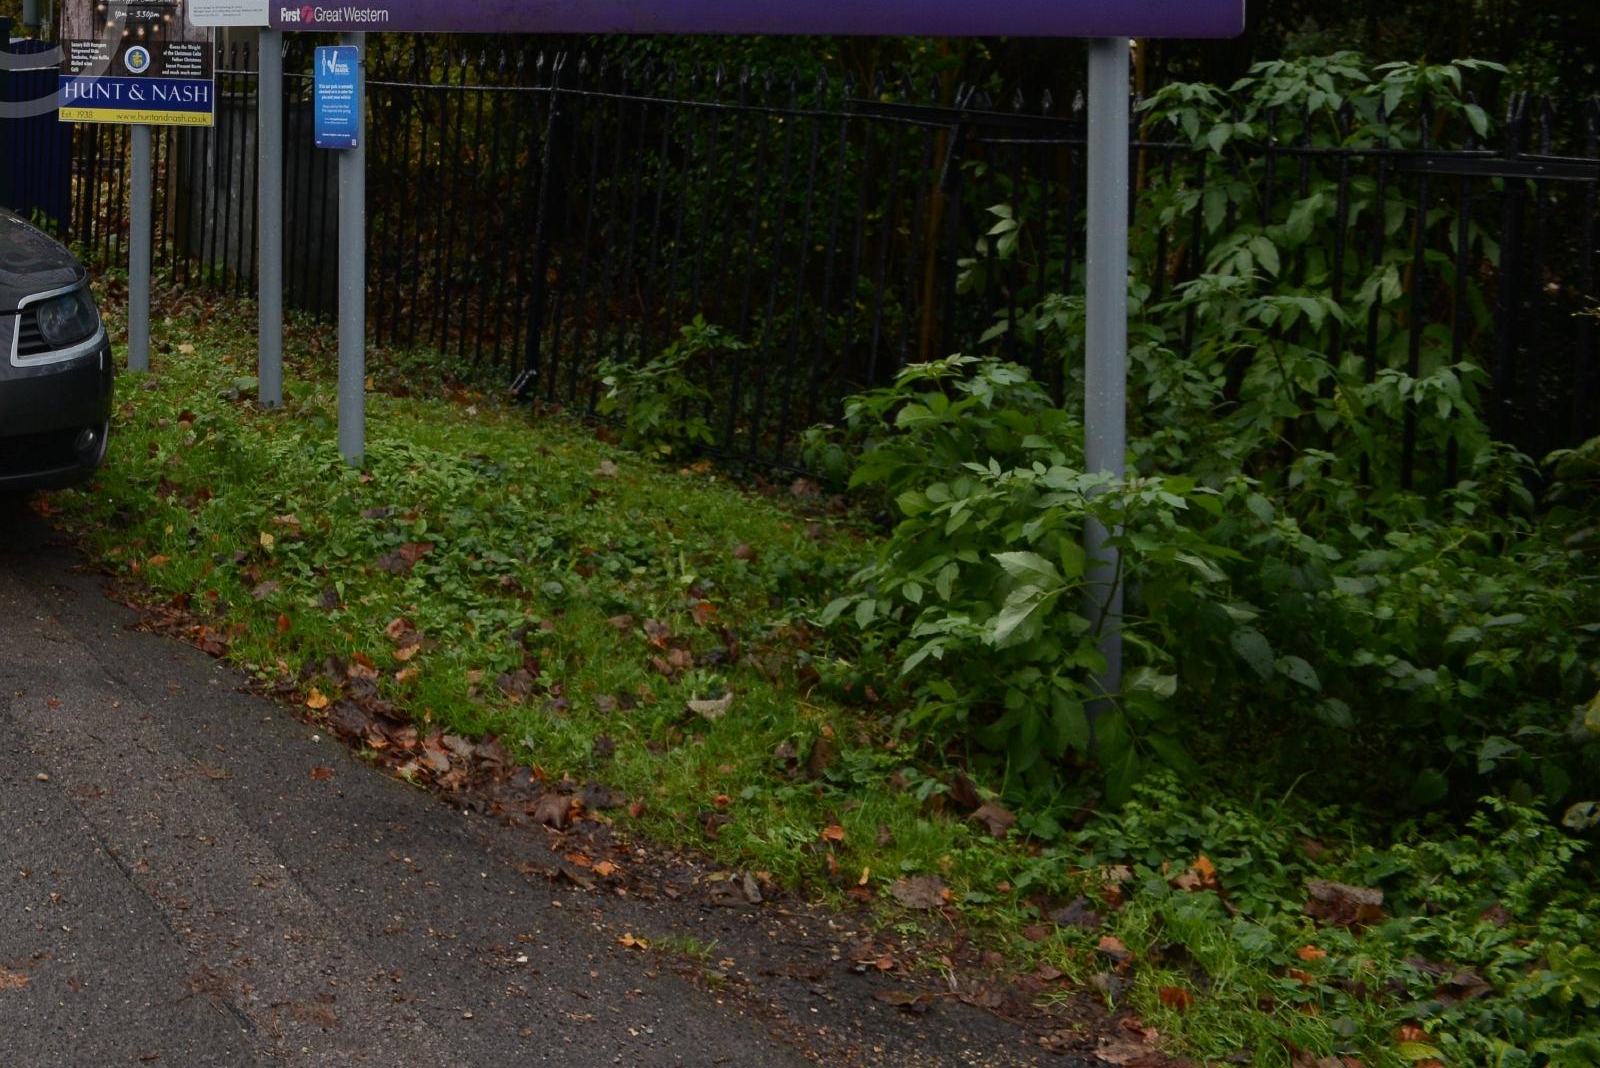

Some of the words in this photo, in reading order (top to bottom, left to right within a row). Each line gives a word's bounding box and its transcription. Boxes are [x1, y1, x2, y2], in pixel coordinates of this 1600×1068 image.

[280, 7, 300, 22] First
[314, 6, 342, 22] Great
[343, 6, 389, 22] Western
[65, 82, 124, 100] HUNT
[128, 84, 146, 101] &
[152, 84, 208, 102] NASH
[116, 112, 208, 123] www.huntandnash.co.uk
